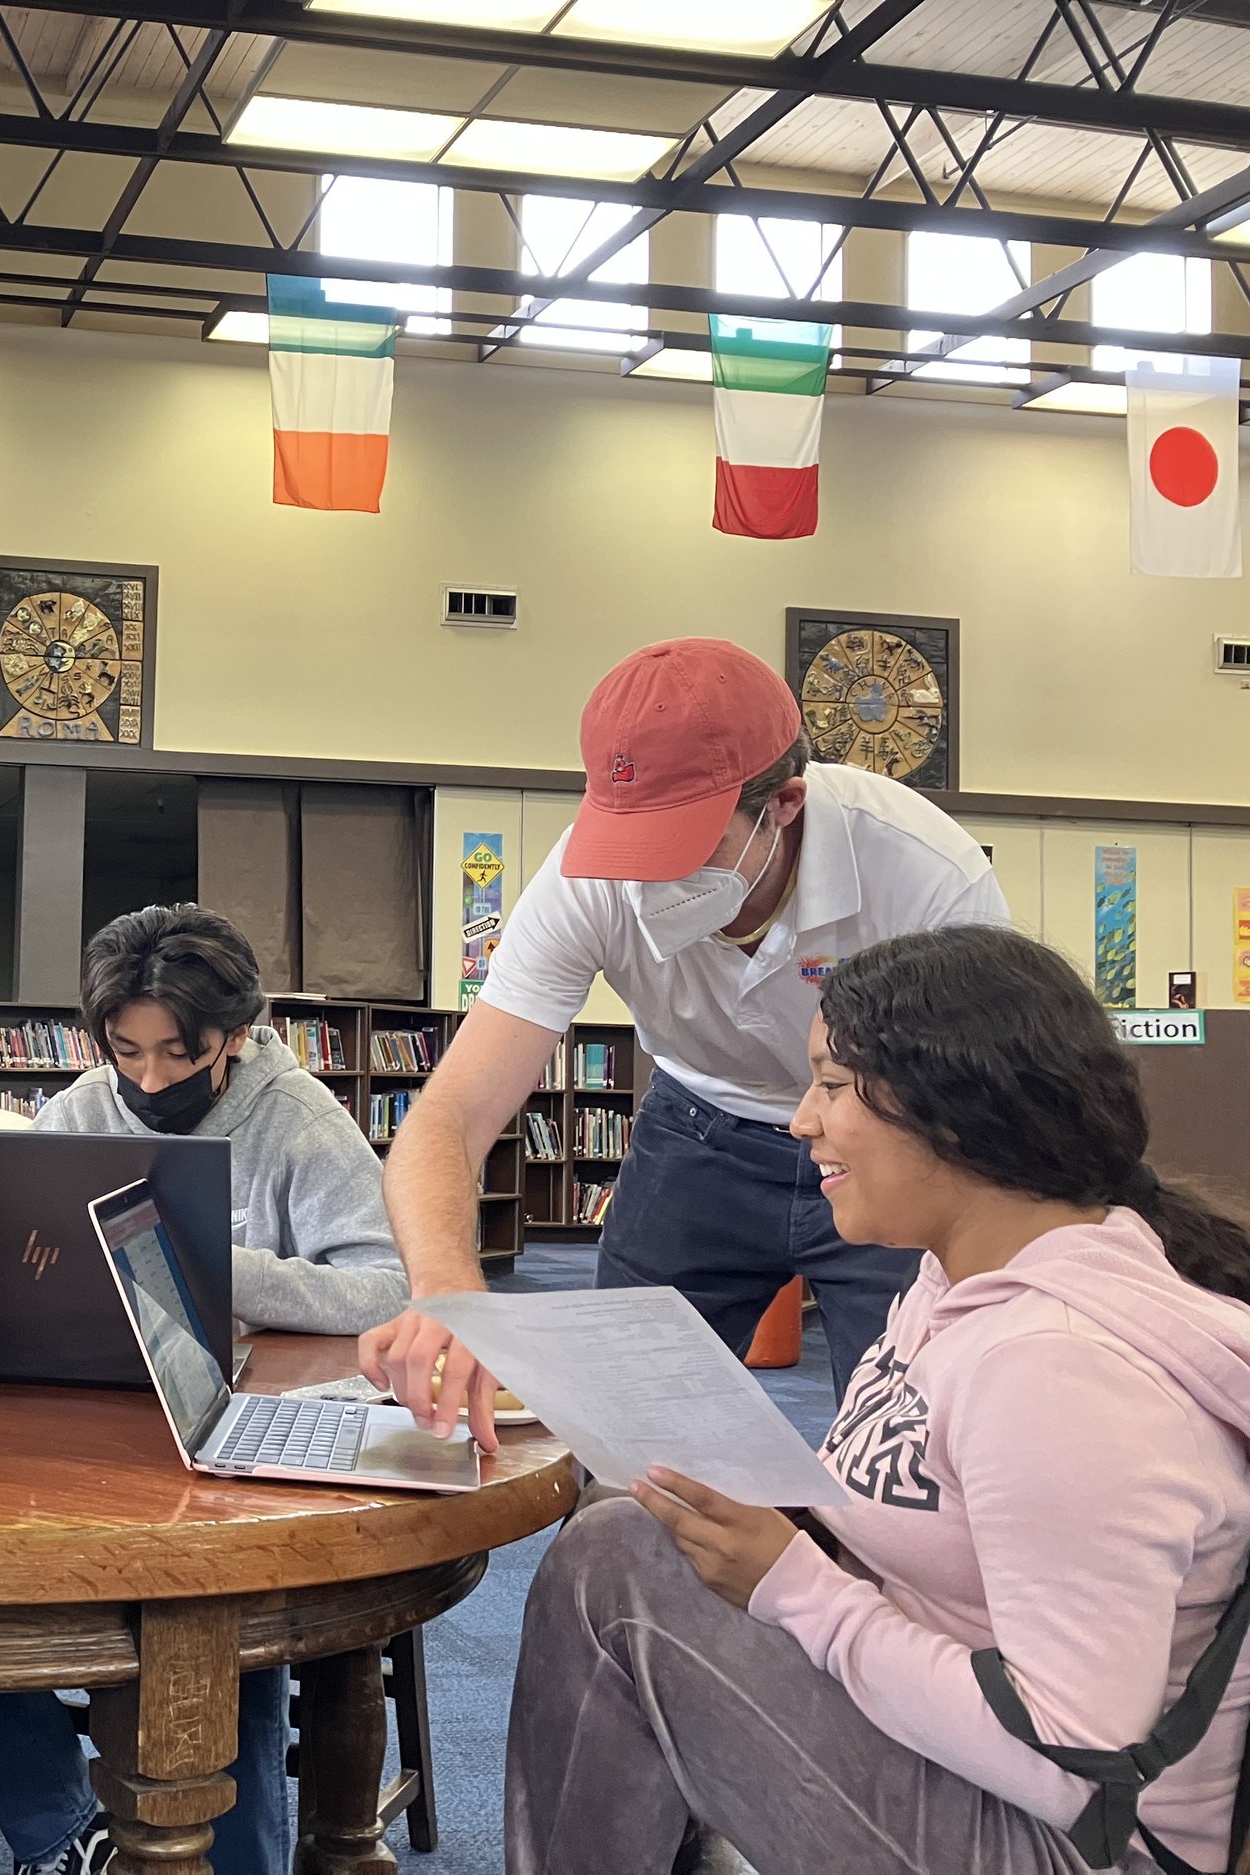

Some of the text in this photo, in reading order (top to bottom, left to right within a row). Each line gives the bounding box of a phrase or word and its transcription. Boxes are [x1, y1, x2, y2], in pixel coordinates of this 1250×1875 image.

[18, 716, 100, 740] ROMA
[474, 852, 492, 863] GO
[464, 862, 501, 870] CONFIDENTLY
[465, 984, 483, 993] YO
[1120, 1018, 1198, 1038] iction
[231, 1208, 248, 1223] NIK
[22, 1230, 60, 1280] hp
